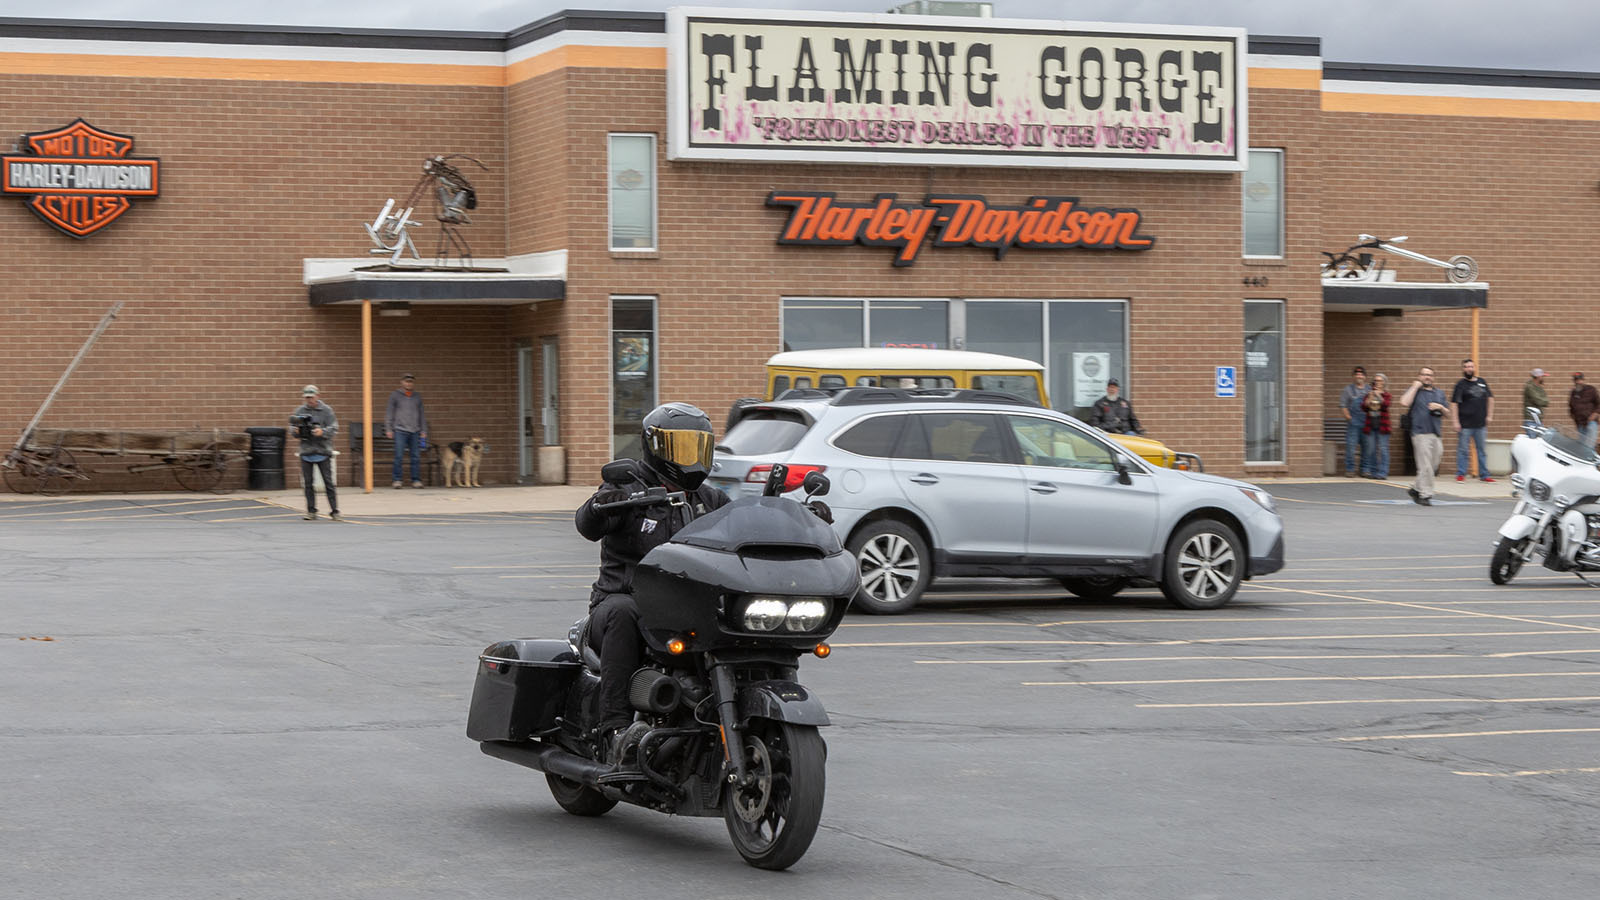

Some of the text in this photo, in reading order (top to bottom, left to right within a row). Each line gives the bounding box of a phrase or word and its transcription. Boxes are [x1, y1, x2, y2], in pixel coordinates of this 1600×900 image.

[702, 33, 1223, 144] FLAMING GORGE
[43, 128, 119, 157] MOTOR
[922, 120, 1015, 148] DEALER
[1021, 124, 1046, 147] IN
[1051, 125, 1096, 148] THE
[9, 162, 152, 190] HARLEY-DAVIDSON
[44, 195, 120, 228] CYCLES
[772, 195, 1153, 261] Harley-Davidson
[1242, 275, 1269, 288] 440
